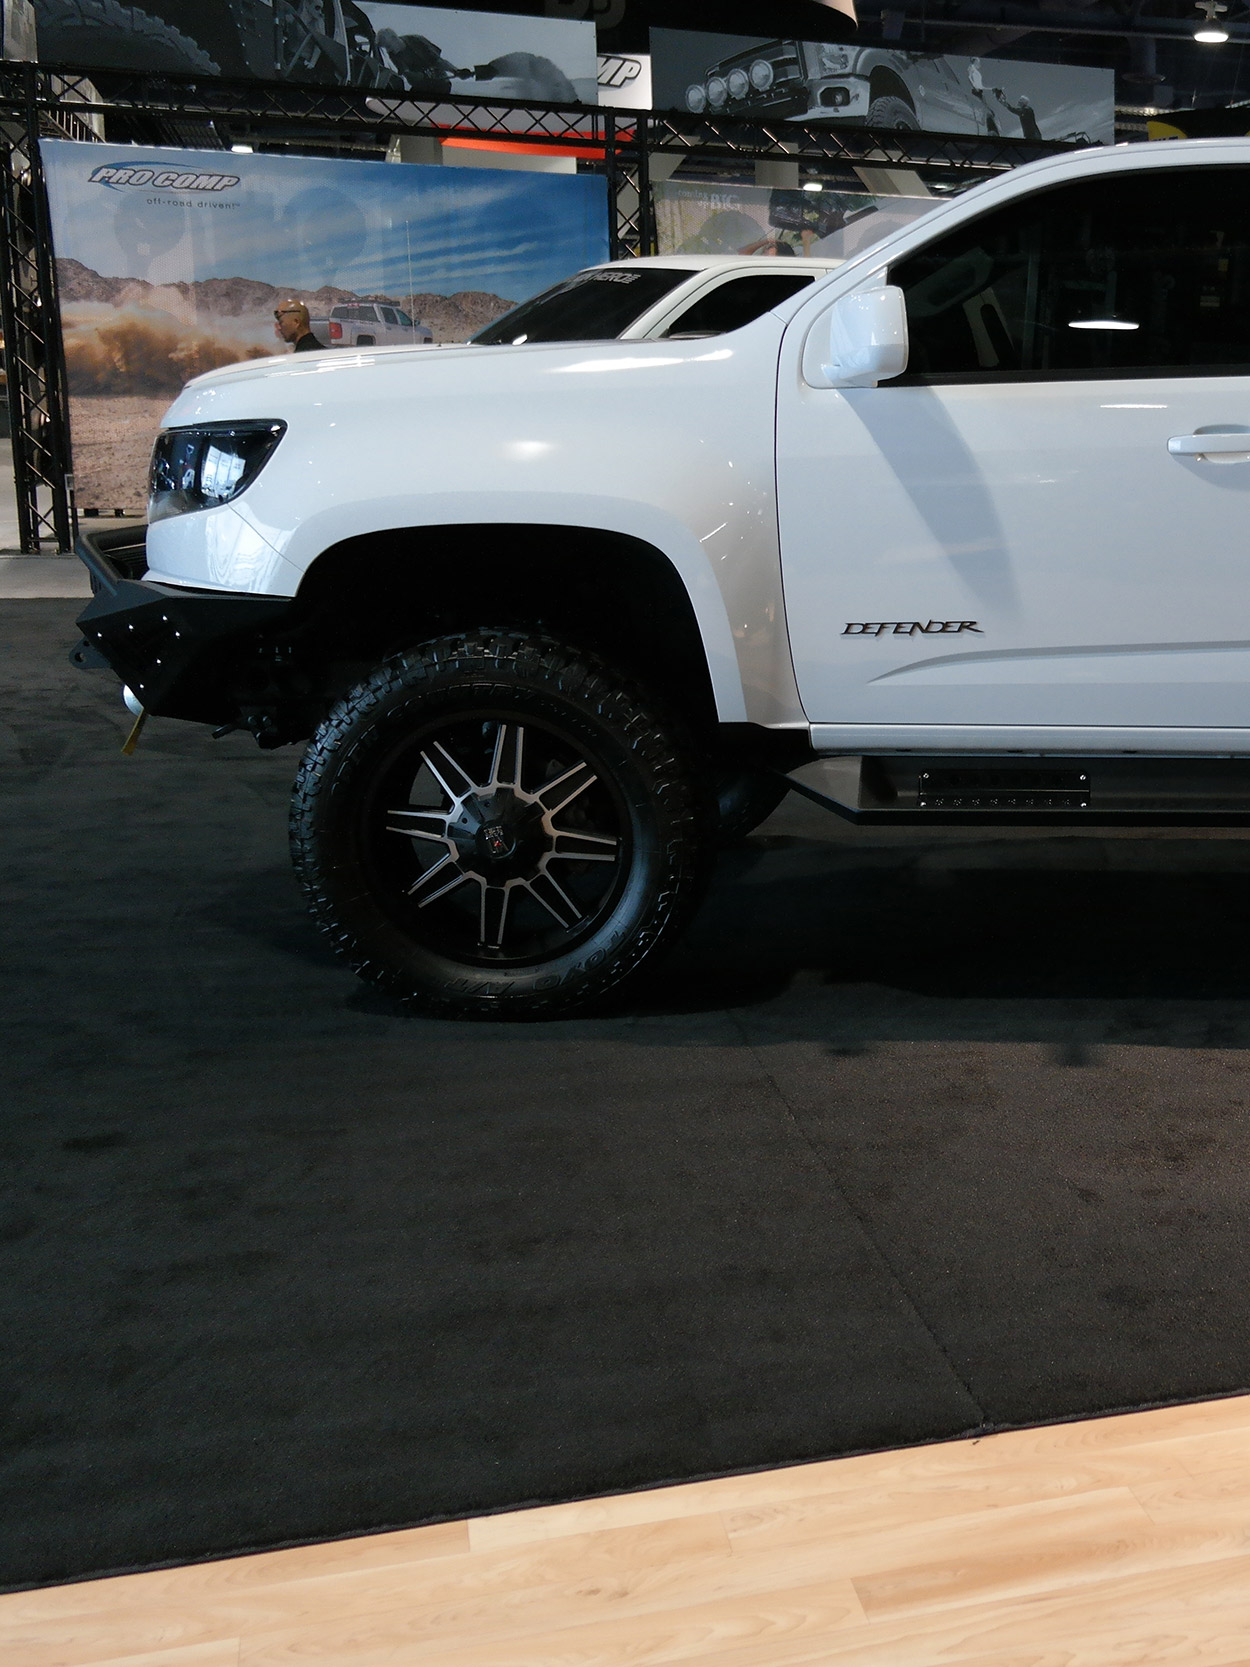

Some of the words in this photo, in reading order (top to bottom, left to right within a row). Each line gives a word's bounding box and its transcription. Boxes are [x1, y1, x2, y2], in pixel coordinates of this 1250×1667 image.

[88, 166, 154, 186] PRO
[152, 171, 240, 191] COMP
[146, 197, 193, 208] off-road
[840, 619, 985, 637] DEFENDER
